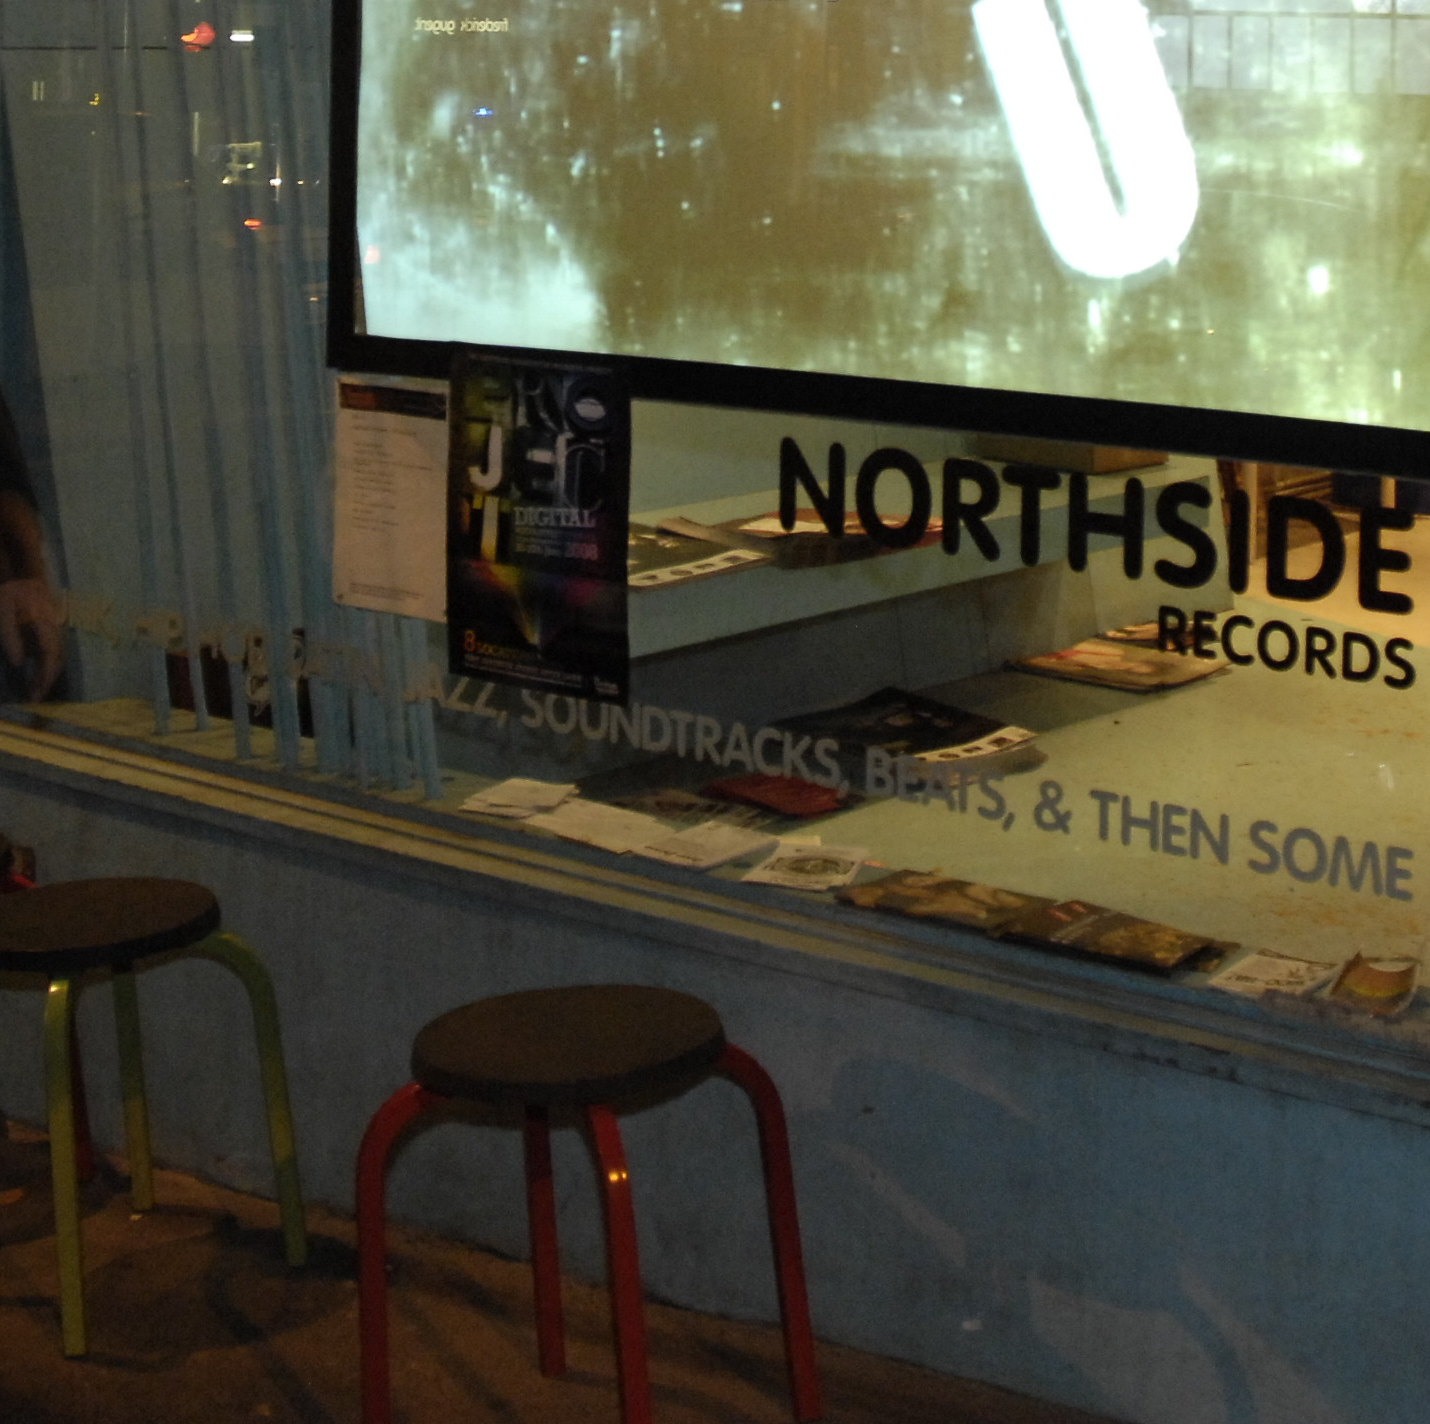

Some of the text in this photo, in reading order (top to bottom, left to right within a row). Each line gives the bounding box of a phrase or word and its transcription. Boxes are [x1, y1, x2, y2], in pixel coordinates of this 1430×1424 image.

[514, 506, 597, 528] DIGITAL
[778, 436, 1416, 615] NORTHSIDE
[1157, 605, 1417, 690] RECORDS
[520, 683, 850, 800] SOUNDTRACKS,
[865, 746, 1016, 833] BEATS,
[1034, 780, 1073, 835] &
[1090, 789, 1231, 866] THEN
[1248, 821, 1414, 902] SOME
